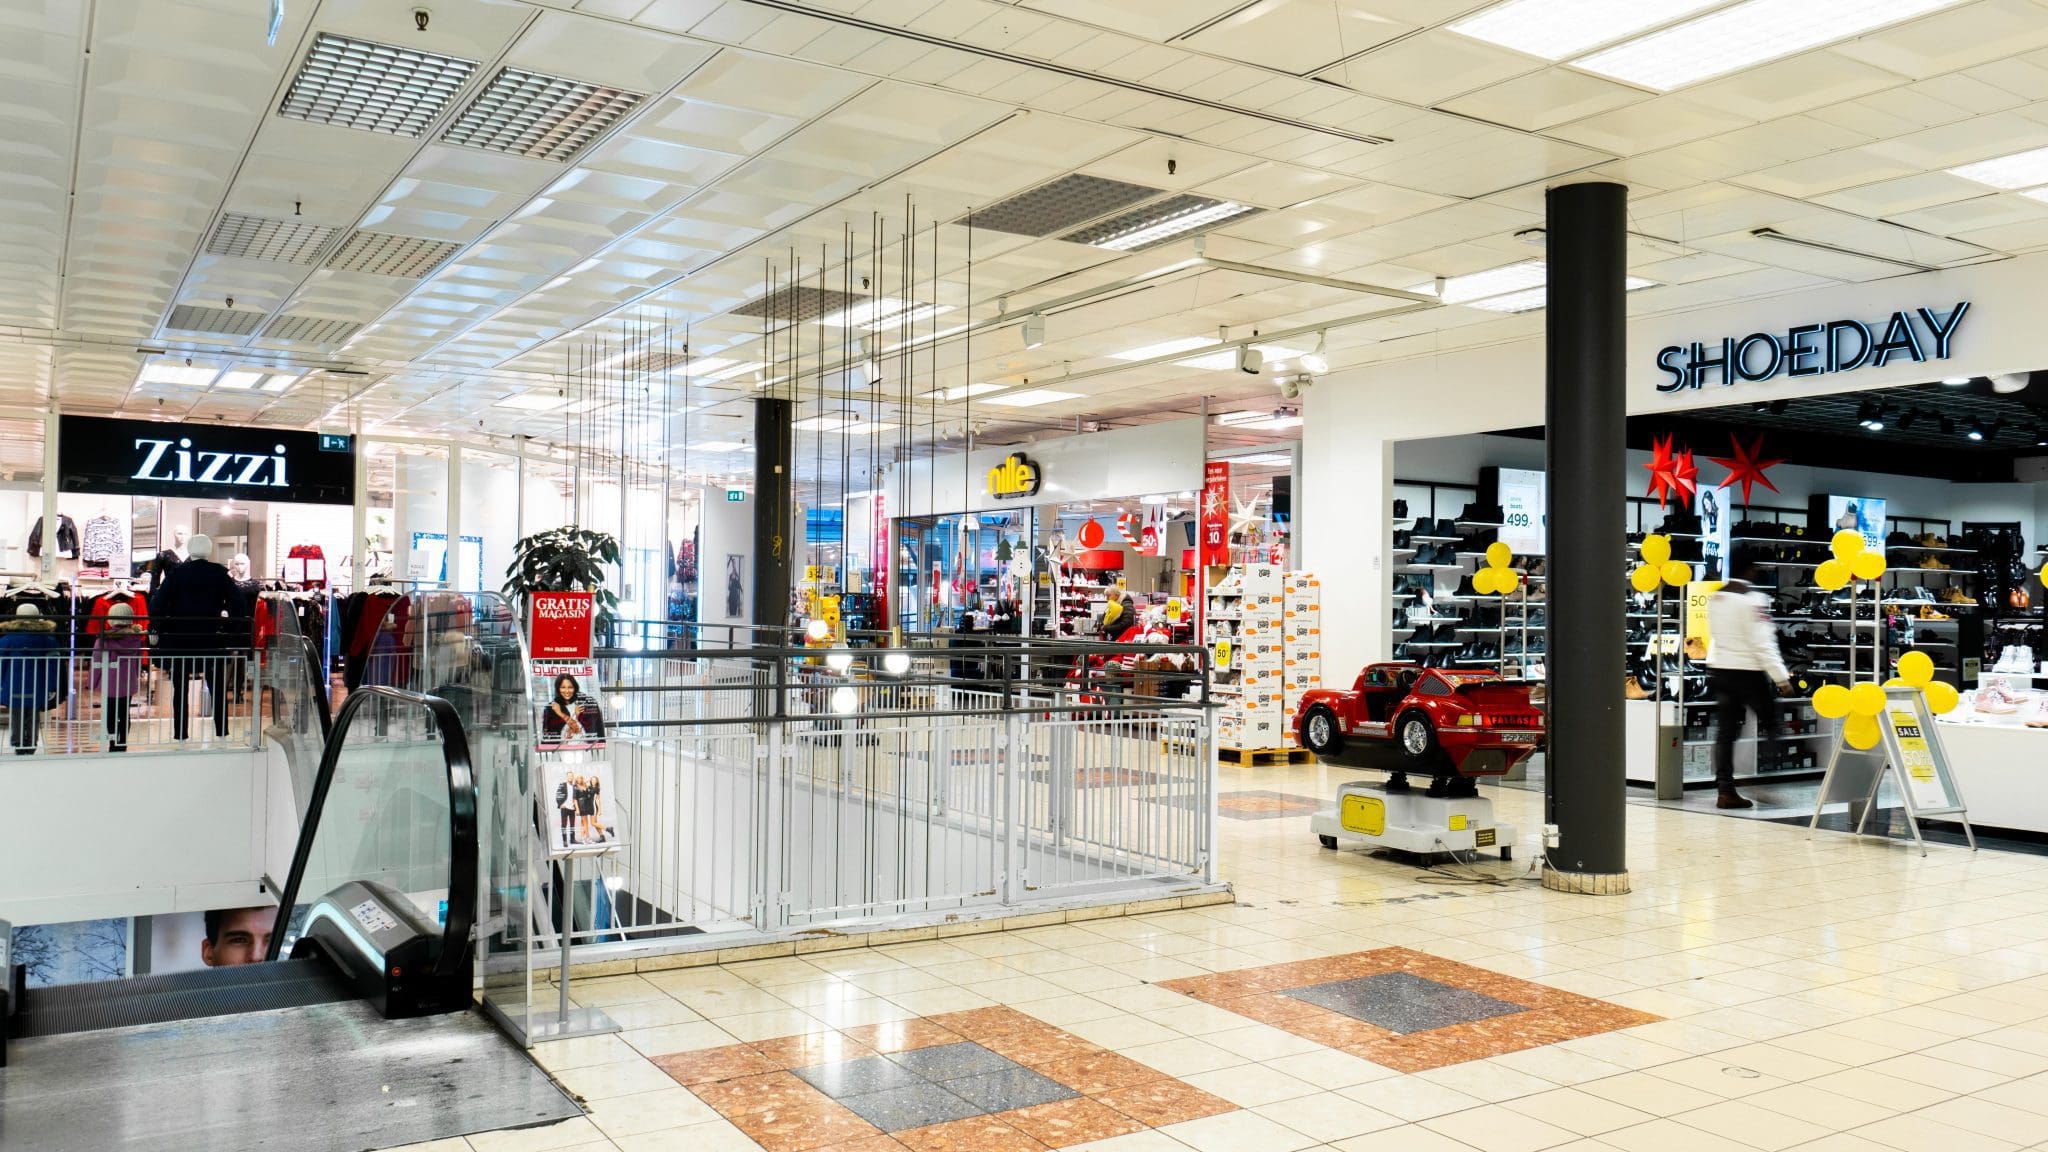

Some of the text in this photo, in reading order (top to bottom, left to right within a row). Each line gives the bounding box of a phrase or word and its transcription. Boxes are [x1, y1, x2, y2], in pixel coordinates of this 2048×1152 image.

[1656, 301, 1971, 393] SHOEDAY
[131, 438, 289, 487] Zizzi
[988, 455, 1031, 495] nille
[535, 597, 590, 610] GRATIS
[539, 608, 586, 619] MAGASIN
[1897, 727, 1920, 737] SALE
